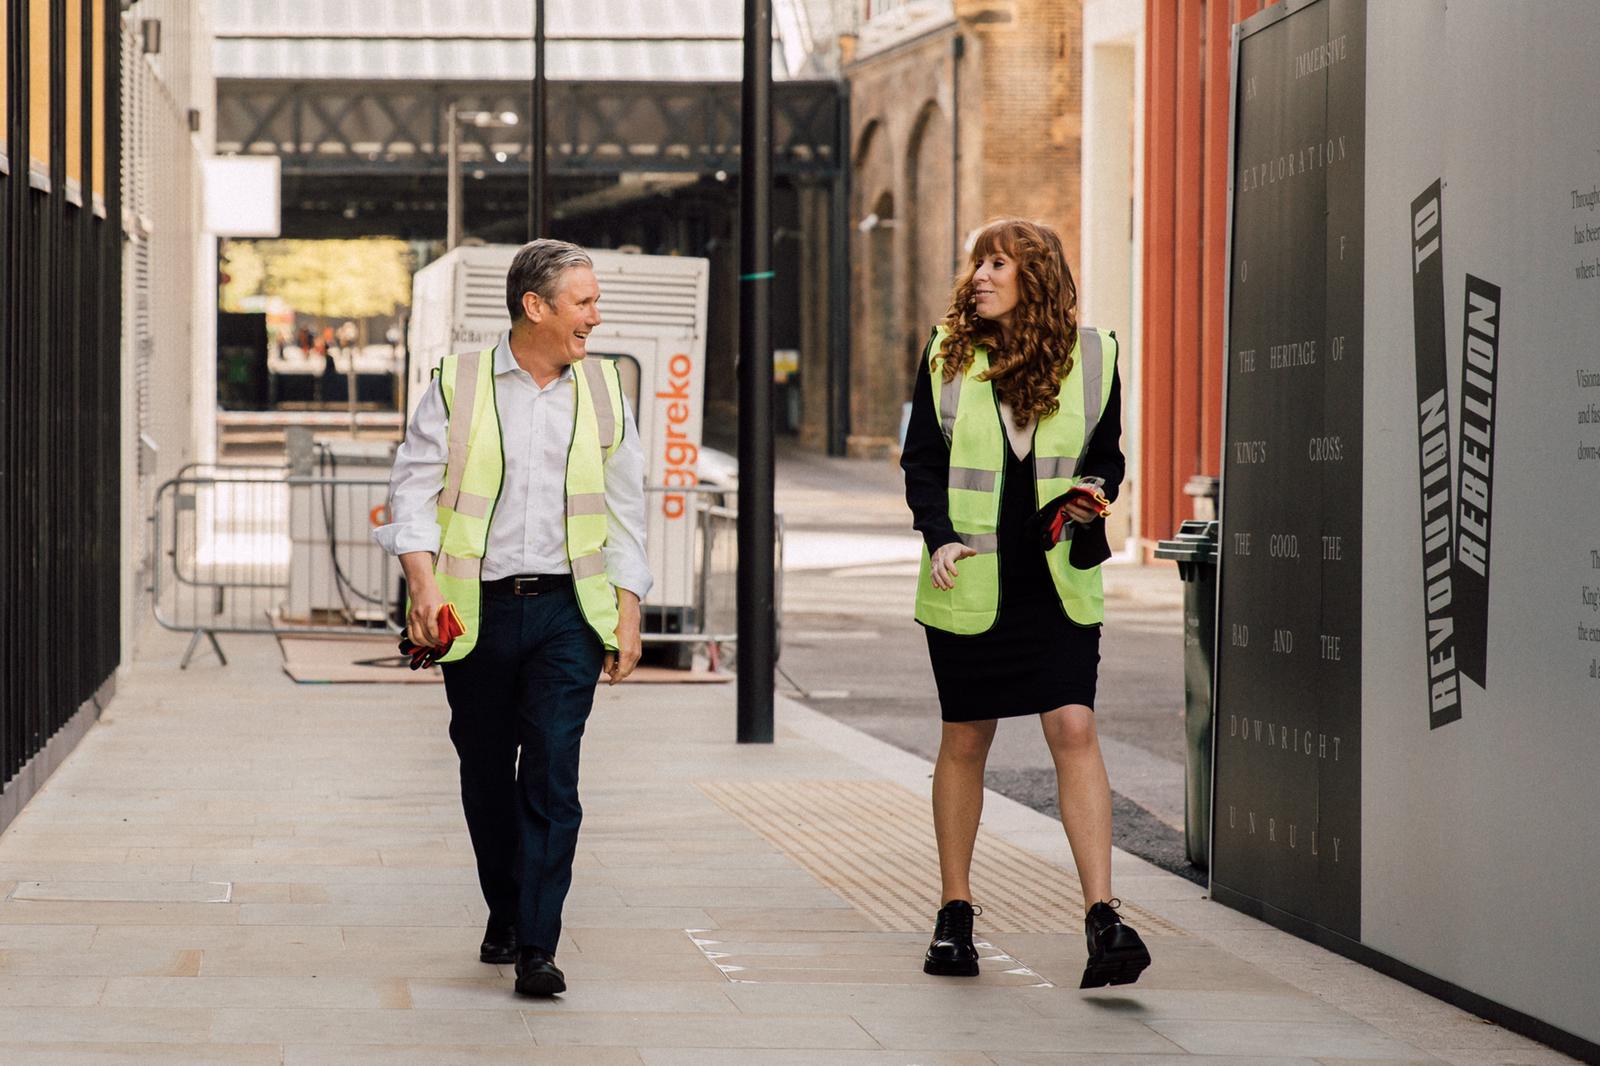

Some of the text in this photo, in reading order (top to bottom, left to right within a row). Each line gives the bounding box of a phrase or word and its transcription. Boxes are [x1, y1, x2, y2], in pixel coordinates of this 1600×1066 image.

[1295, 35, 1347, 80] IMMERSIVE
[1243, 135, 1346, 192] EXPLORATION
[1239, 336, 1345, 373] THE HERITAGE OF
[655, 353, 699, 519] aggreko
[1414, 197, 1458, 713] REVOLUTION TO
[1458, 290, 1497, 578] REBELLION
[1234, 533, 1342, 560] THE GOOD, THE
[1232, 623, 1341, 661] BAD AND THE
[1231, 714, 1341, 761] DOWNRIGHT
[1230, 805, 1340, 863] UNRULY
